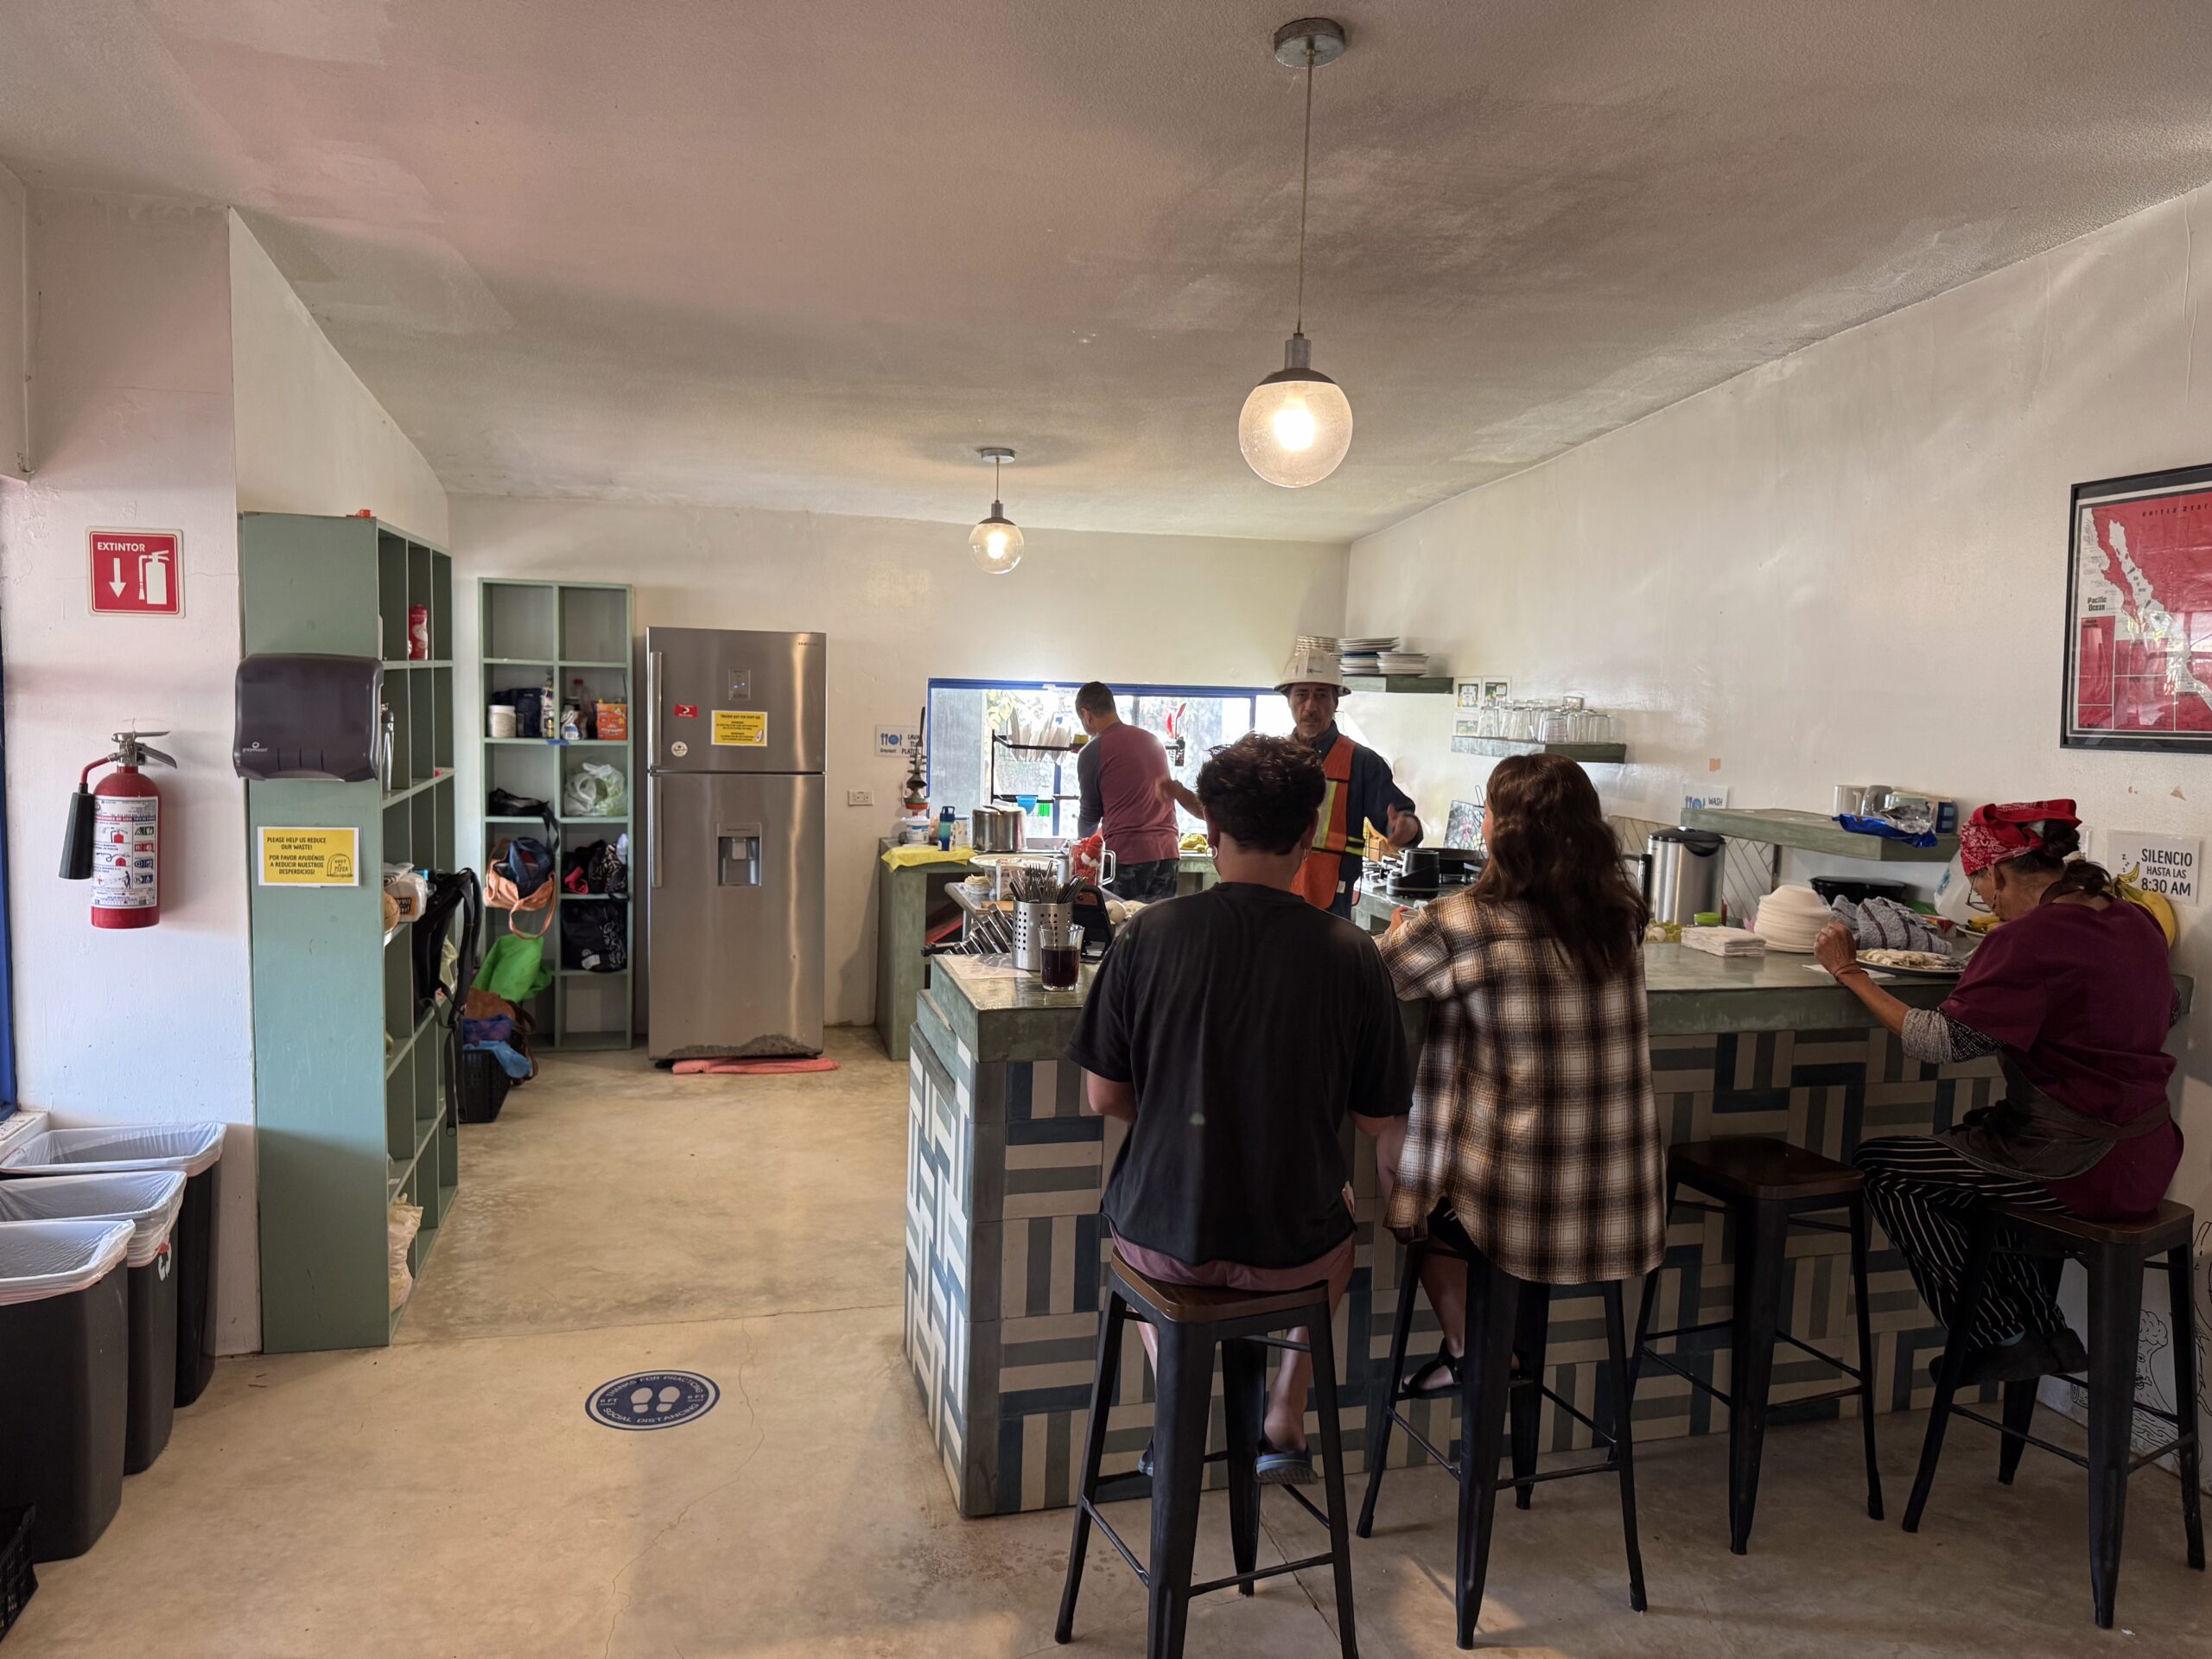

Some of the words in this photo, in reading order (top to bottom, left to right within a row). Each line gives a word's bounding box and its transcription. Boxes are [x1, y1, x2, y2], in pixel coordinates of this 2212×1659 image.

[2142, 507, 2177, 517] UNITED
[2183, 503, 2212, 512] STAT
[97, 542, 146, 552] EXTINTOR
[1707, 797, 1723, 806] WASH
[2141, 849, 2193, 867] SILENCIO
[2147, 866, 2171, 877] HASTA
[2172, 868, 2187, 880] LAS
[2141, 878, 2168, 893] 8:30
[2170, 881, 2191, 897] AM
[606, 1380, 637, 1397] THANKS
[603, 1407, 632, 1422] SOCIAL
[636, 1403, 699, 1423] DISTANCING
